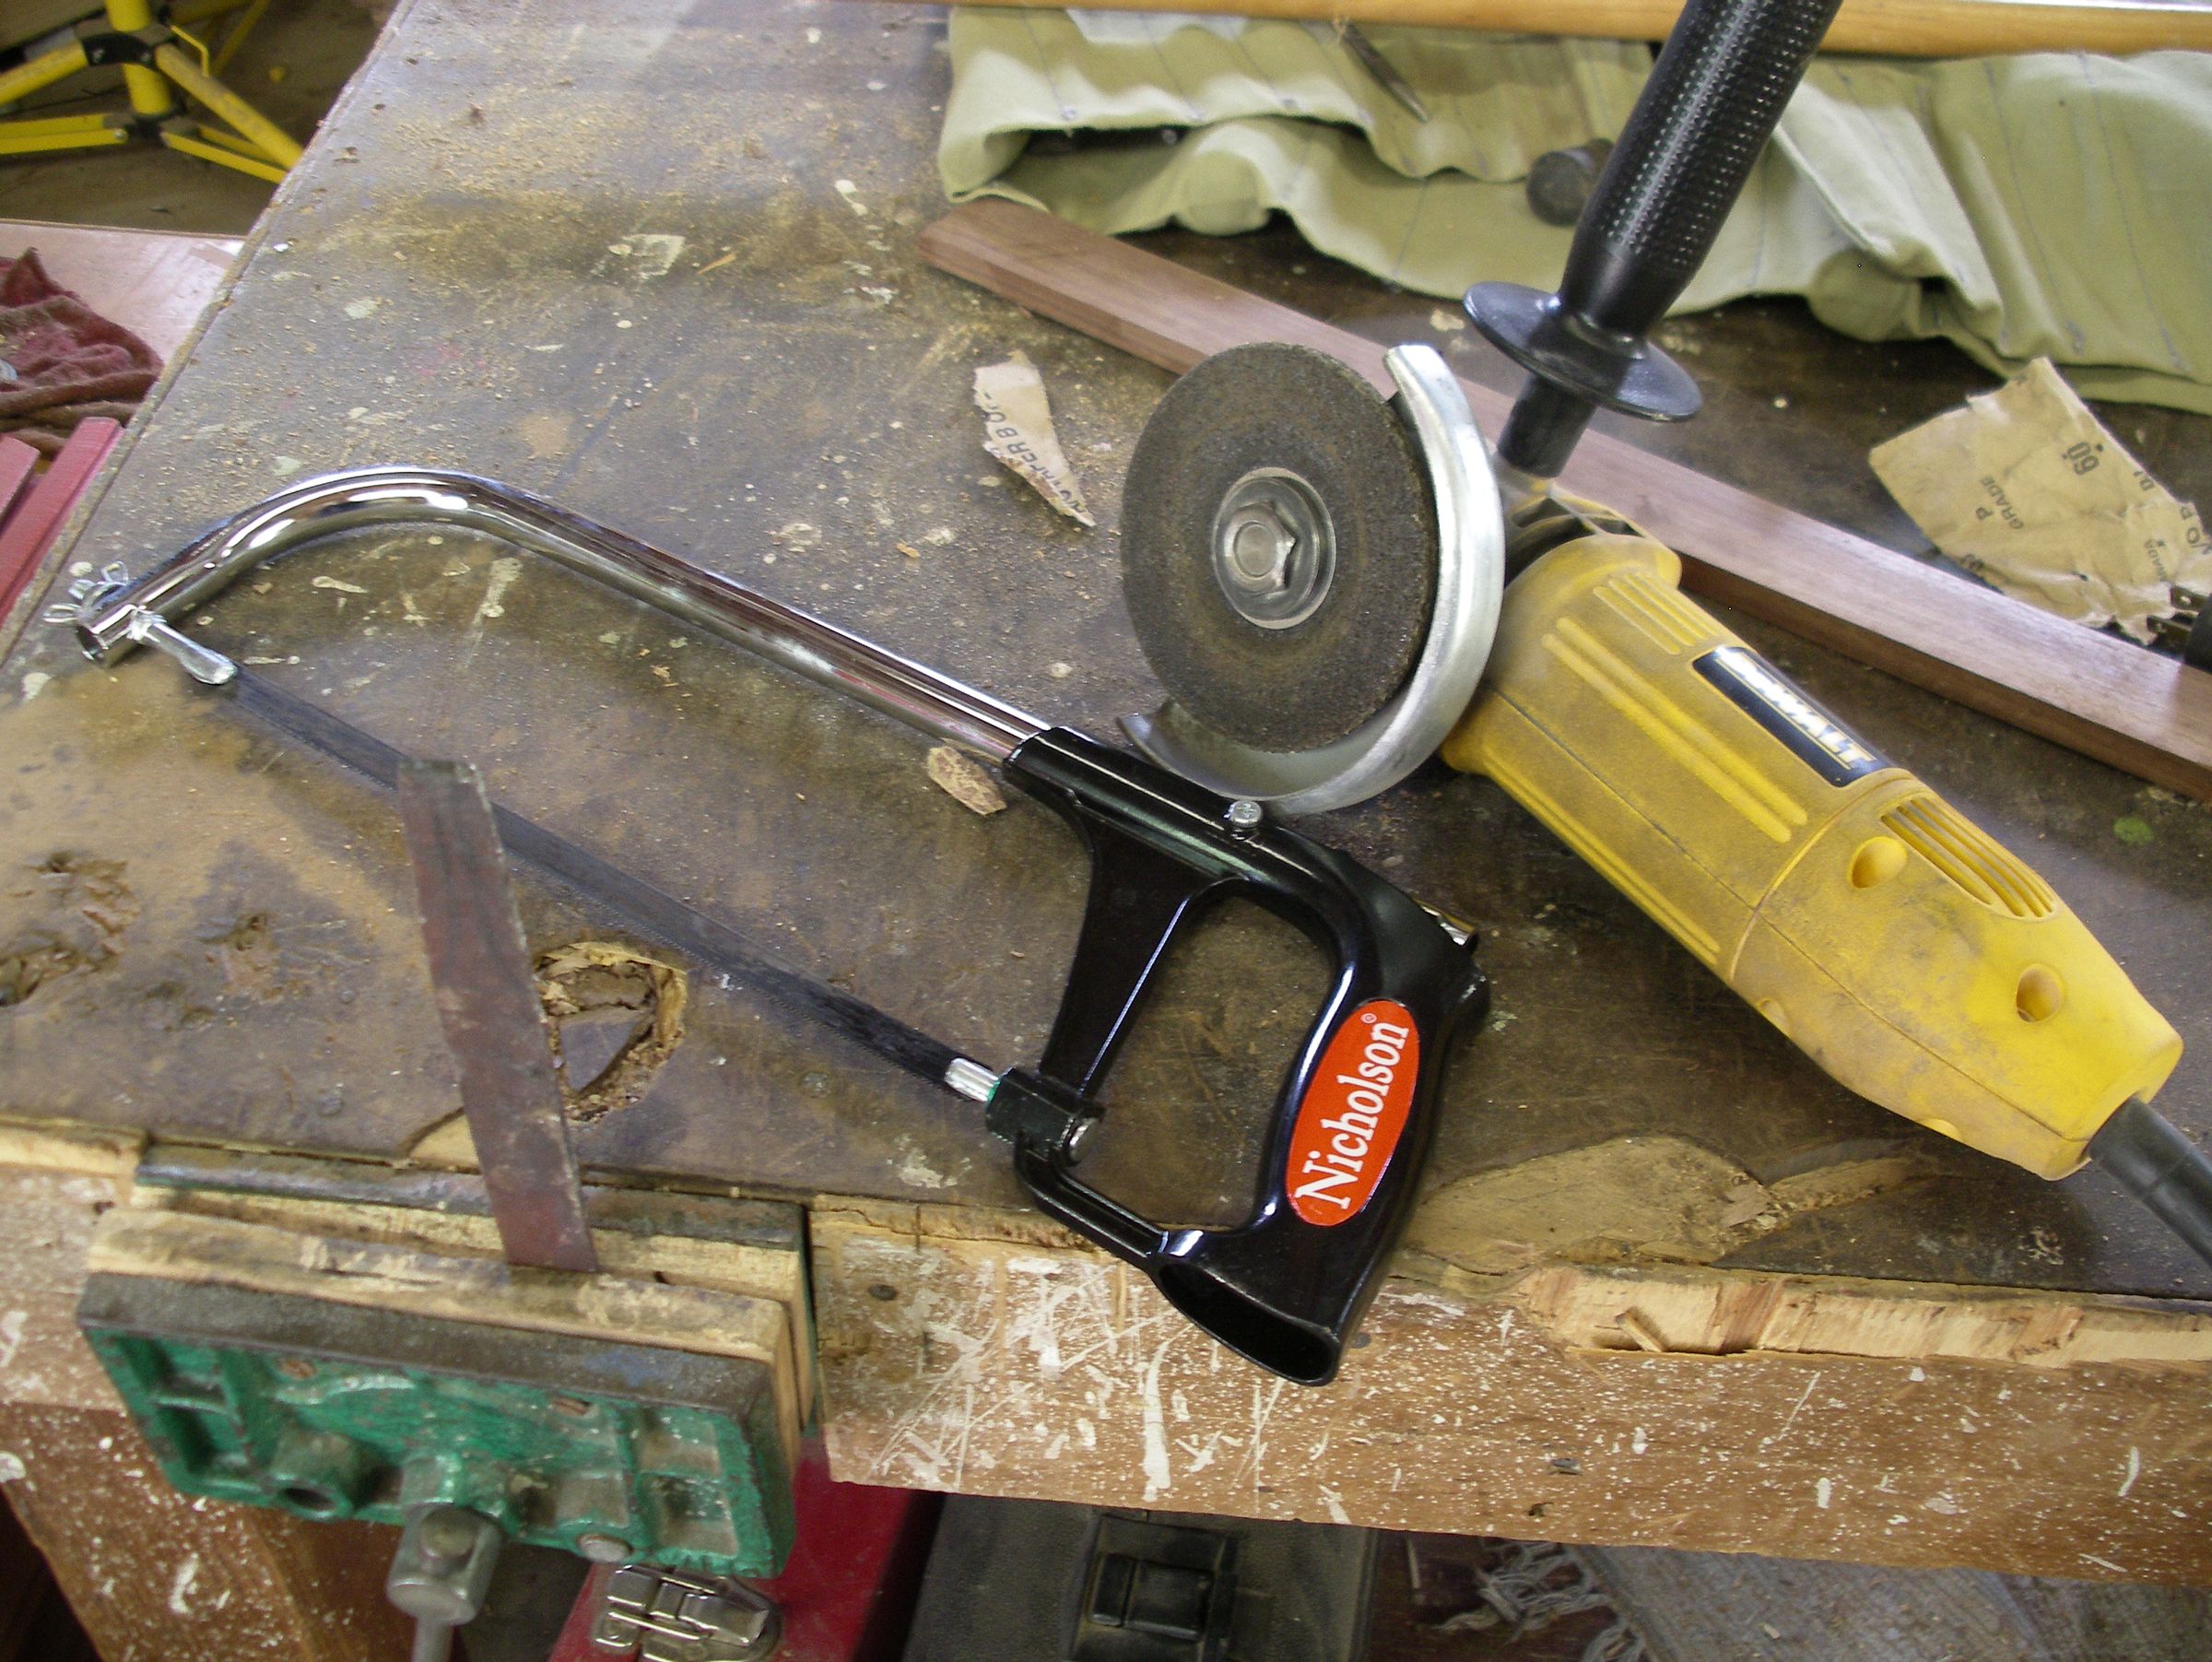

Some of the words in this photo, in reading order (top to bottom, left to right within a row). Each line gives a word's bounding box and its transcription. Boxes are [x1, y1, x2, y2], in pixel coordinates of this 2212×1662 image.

[2067, 442, 2100, 476] 60
[1975, 507, 1994, 521] P
[1981, 476, 2024, 529] GRADE
[2144, 539, 2169, 583] ANADA
[1716, 648, 1877, 762] WALT
[1295, 1021, 1409, 1209] Nicholson
